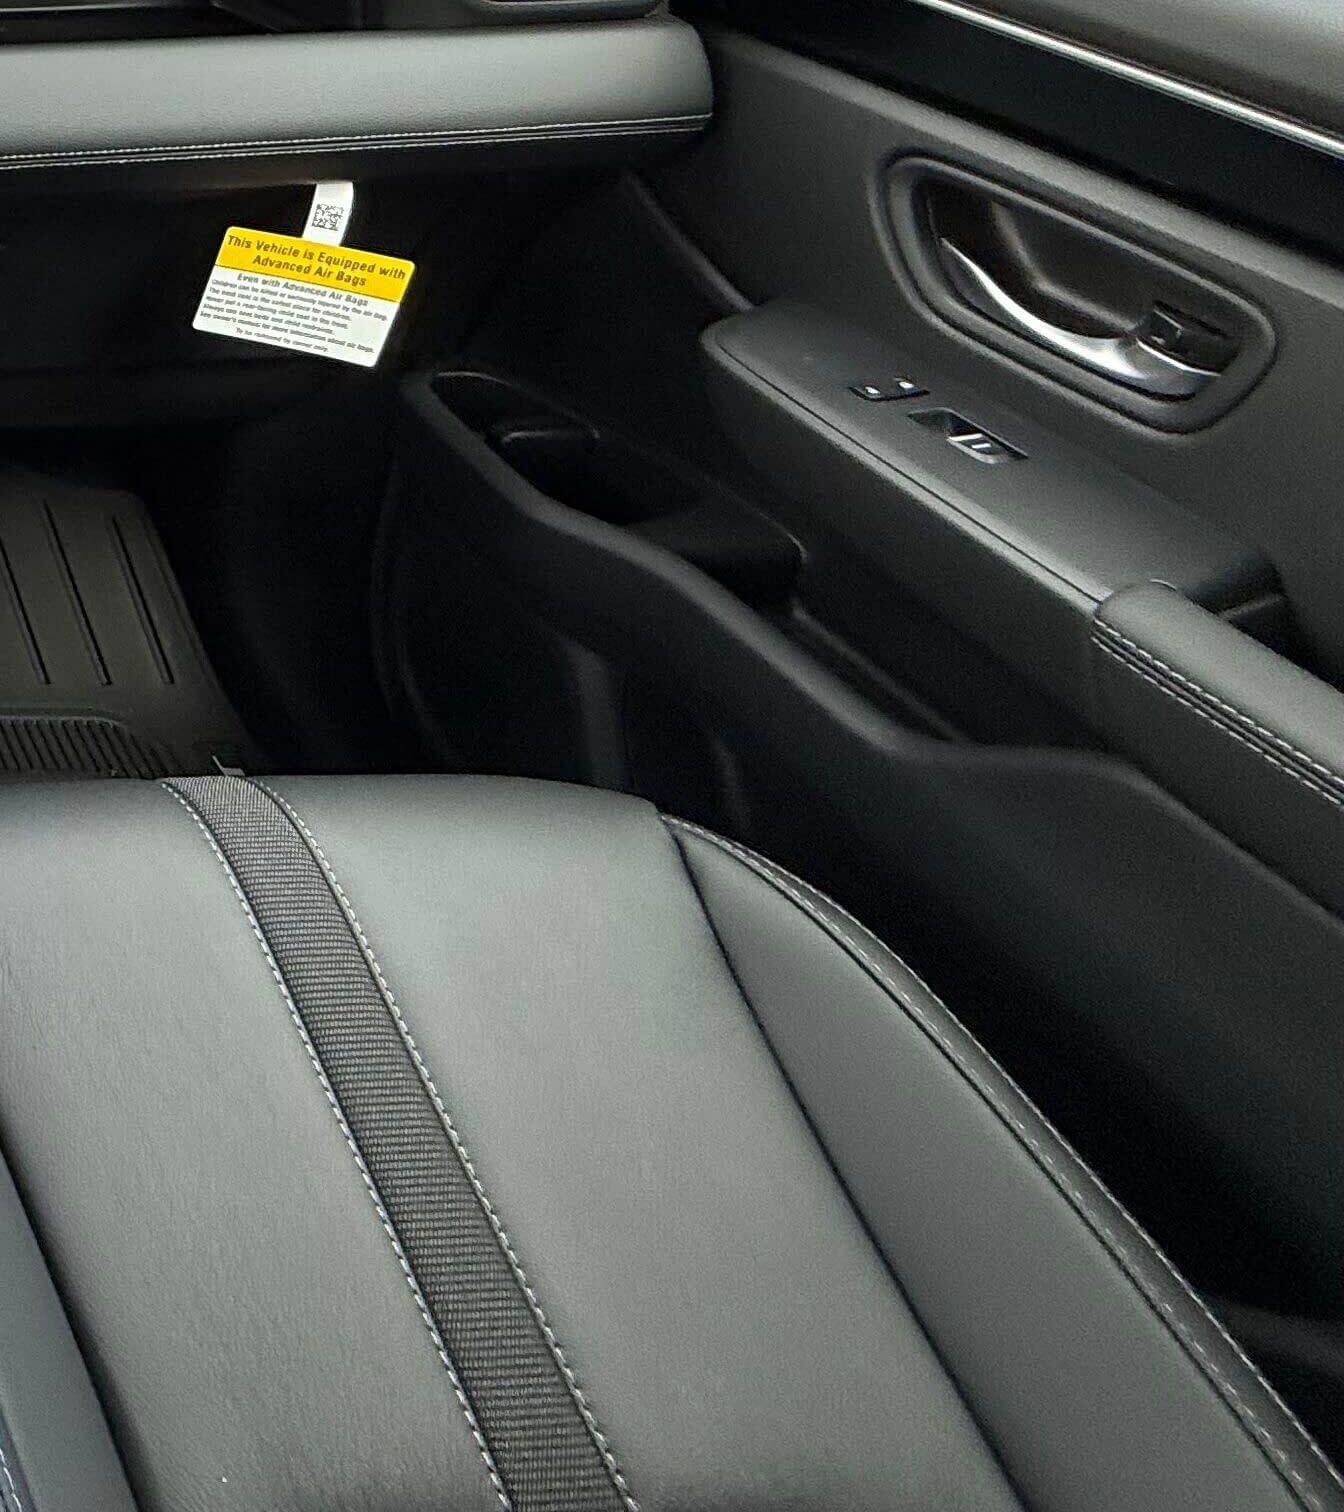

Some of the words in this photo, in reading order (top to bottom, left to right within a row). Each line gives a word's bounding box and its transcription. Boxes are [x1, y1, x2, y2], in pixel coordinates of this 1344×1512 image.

[226, 235, 253, 248] This
[254, 239, 300, 257] Vehicle
[302, 249, 315, 260] is
[316, 252, 376, 274] Equipped
[378, 265, 407, 279] with
[252, 253, 311, 274] Advanced
[313, 265, 333, 279] Air
[334, 271, 367, 287] Bags
[237, 272, 259, 283] Even
[260, 277, 280, 288] with
[282, 281, 327, 297] Advanced
[328, 291, 344, 301] Air
[344, 295, 369, 307] Bags
